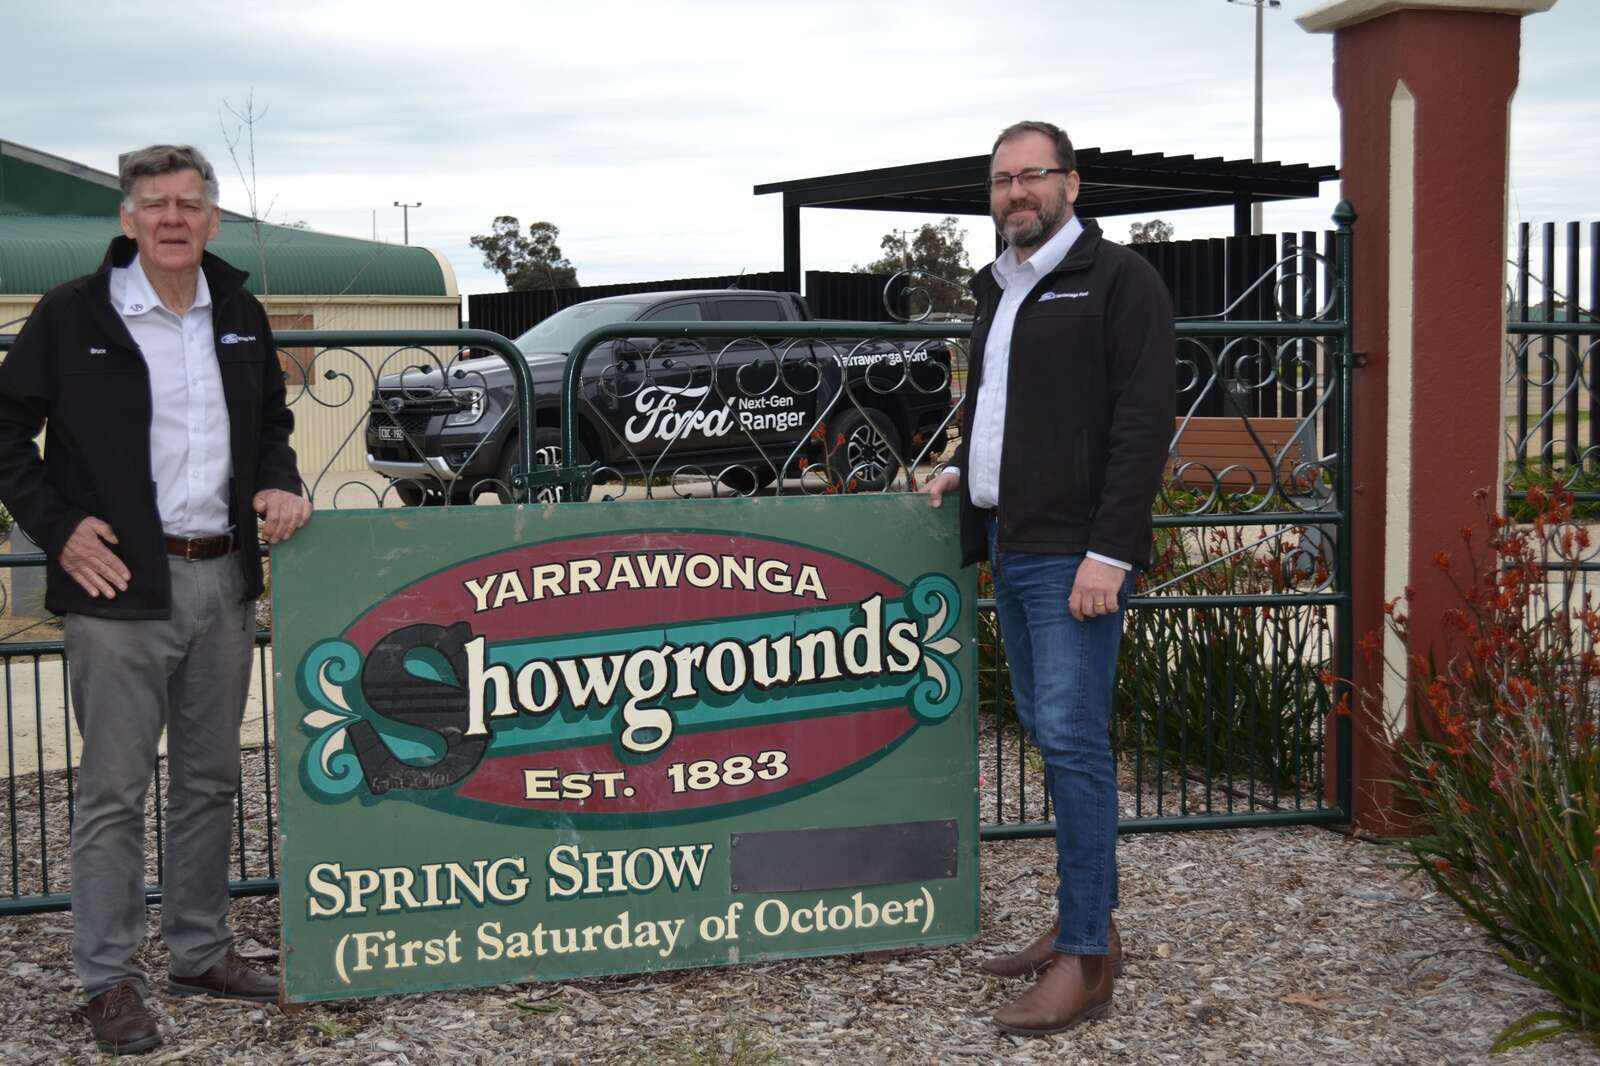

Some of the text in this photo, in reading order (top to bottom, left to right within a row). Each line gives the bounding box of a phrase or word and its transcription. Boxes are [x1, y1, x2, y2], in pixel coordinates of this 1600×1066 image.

[624, 385, 736, 443] Ford
[739, 396, 794, 411] Next-Gen
[740, 411, 806, 432] Ranger
[464, 553, 828, 612] YARRAWONGA
[346, 594, 924, 795] Showgrounds
[667, 750, 790, 793] 1883
[335, 887, 937, 983] (First Saturday of October)
